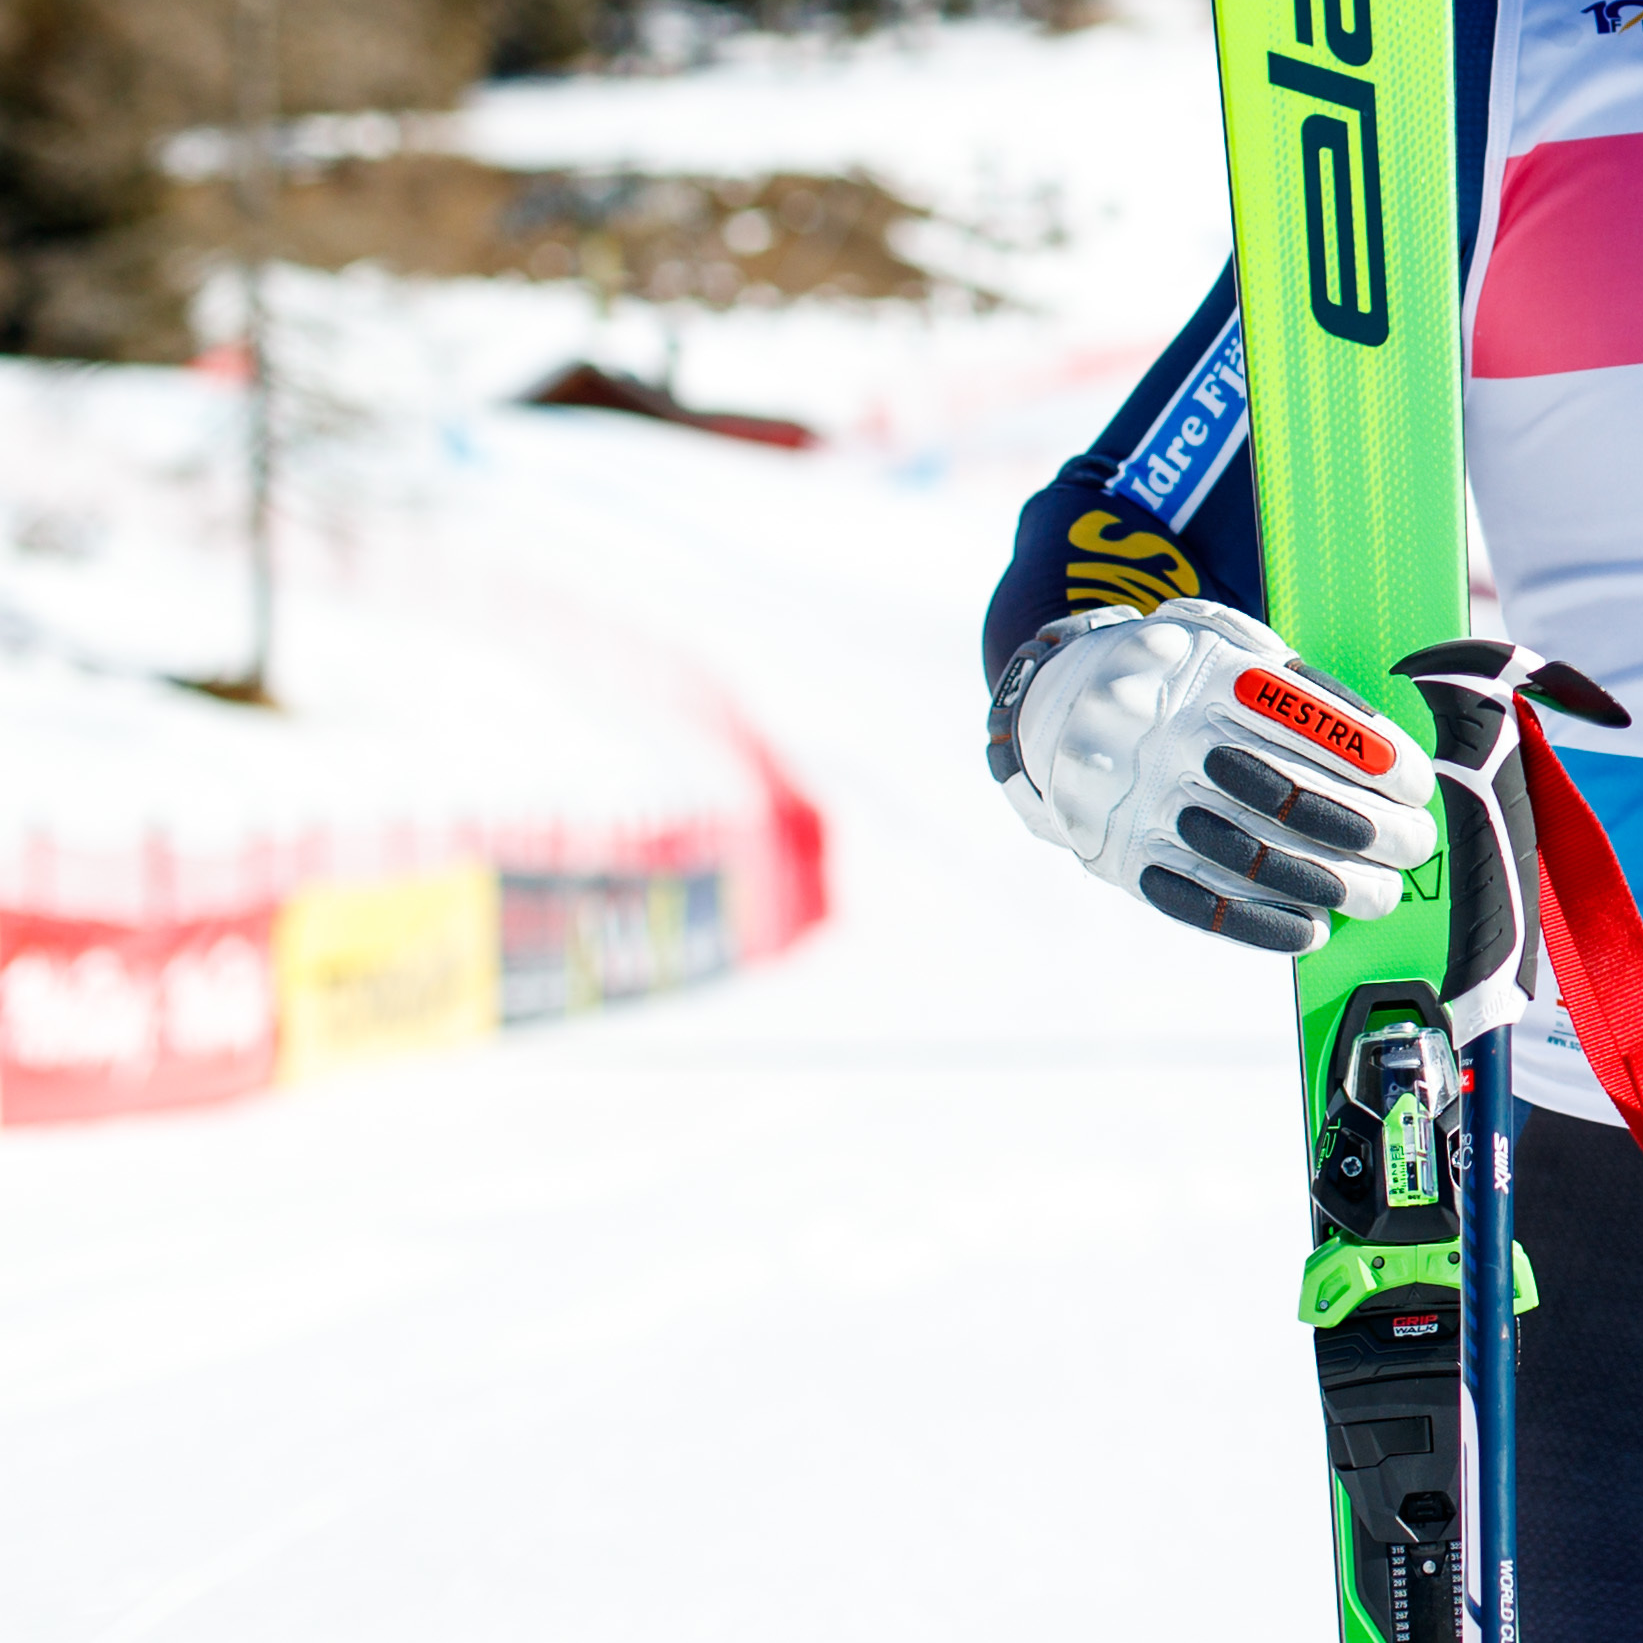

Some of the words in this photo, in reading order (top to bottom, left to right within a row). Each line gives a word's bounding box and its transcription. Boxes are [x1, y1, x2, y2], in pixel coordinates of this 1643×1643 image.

[1131, 416, 1209, 511] Idre
[1255, 681, 1366, 761] HESTRA
[1393, 1314, 1438, 1326] GRIP
[1395, 1323, 1434, 1335] WALK
[1499, 1559, 1514, 1622] WORLD
